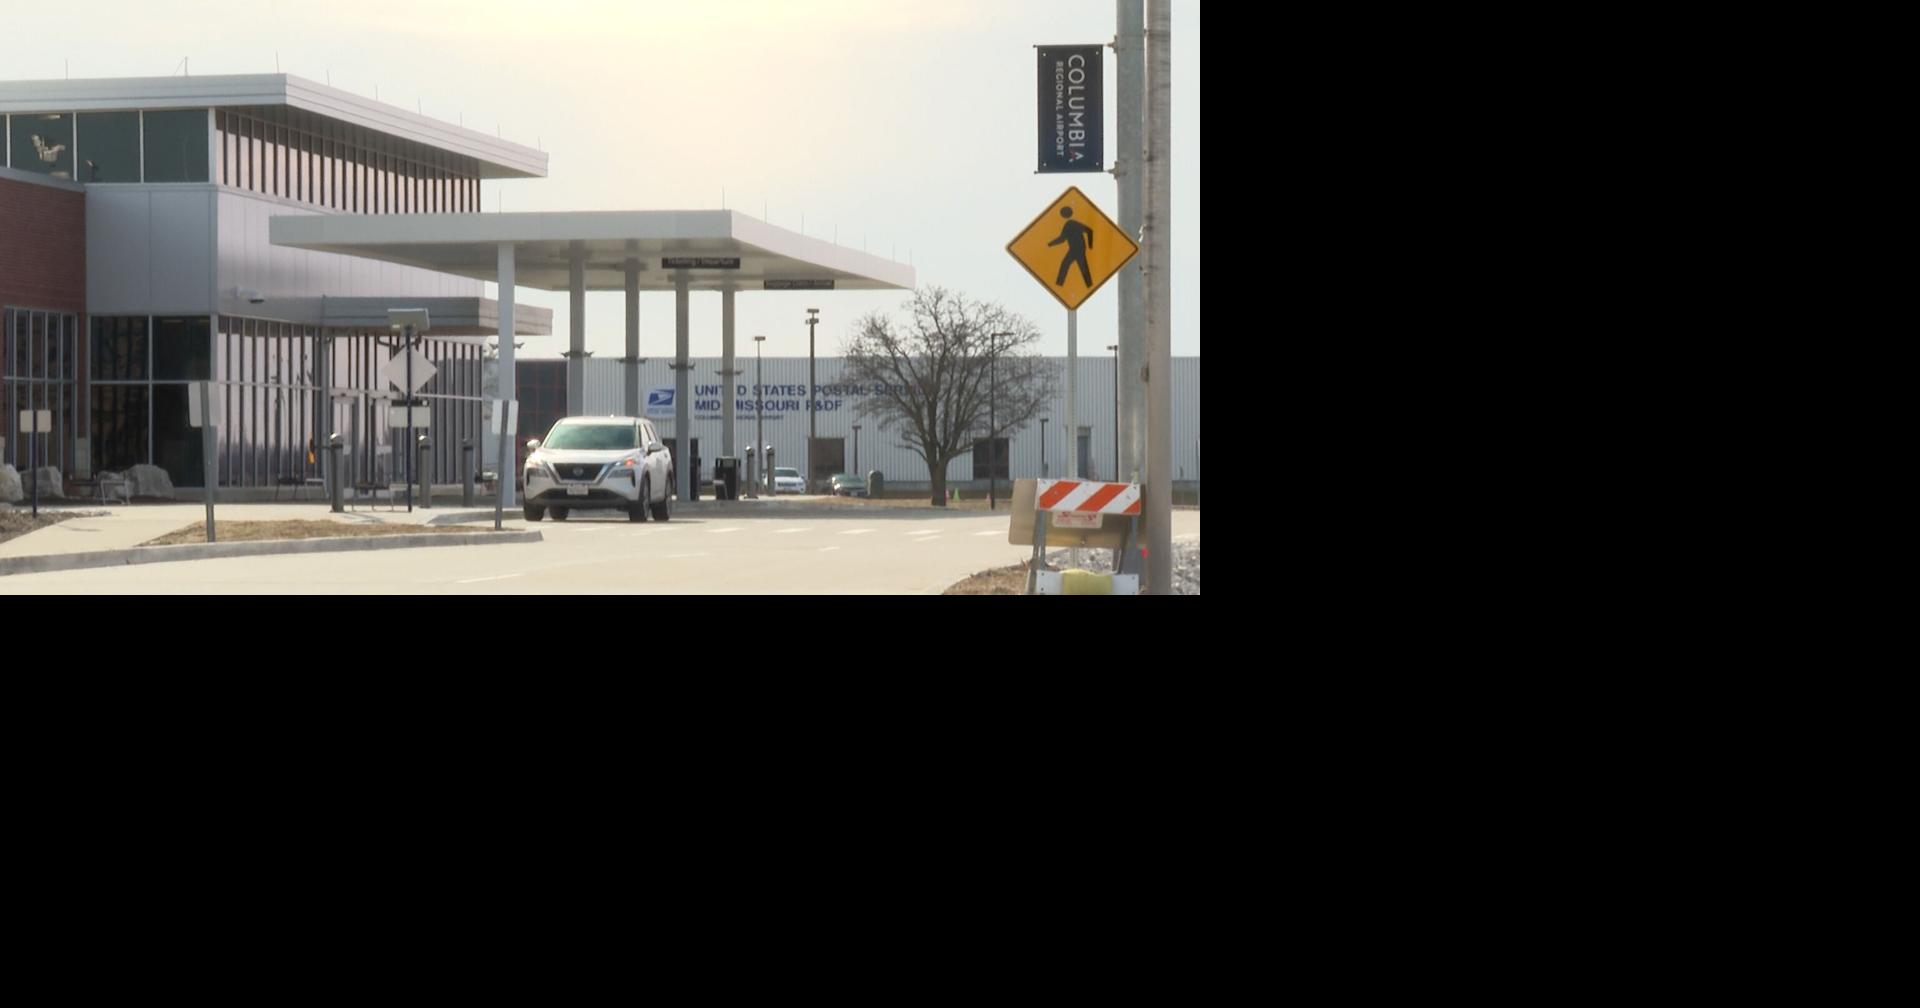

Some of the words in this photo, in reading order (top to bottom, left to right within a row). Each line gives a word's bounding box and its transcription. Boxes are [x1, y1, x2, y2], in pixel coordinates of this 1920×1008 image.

[1055, 61, 1064, 110] REGIONAL
[1068, 54, 1085, 162] COLUMBIA
[1055, 113, 1065, 156] AIRPORT
[694, 384, 747, 397] UNID
[752, 384, 807, 397] STATES
[812, 384, 868, 397] POSTAL
